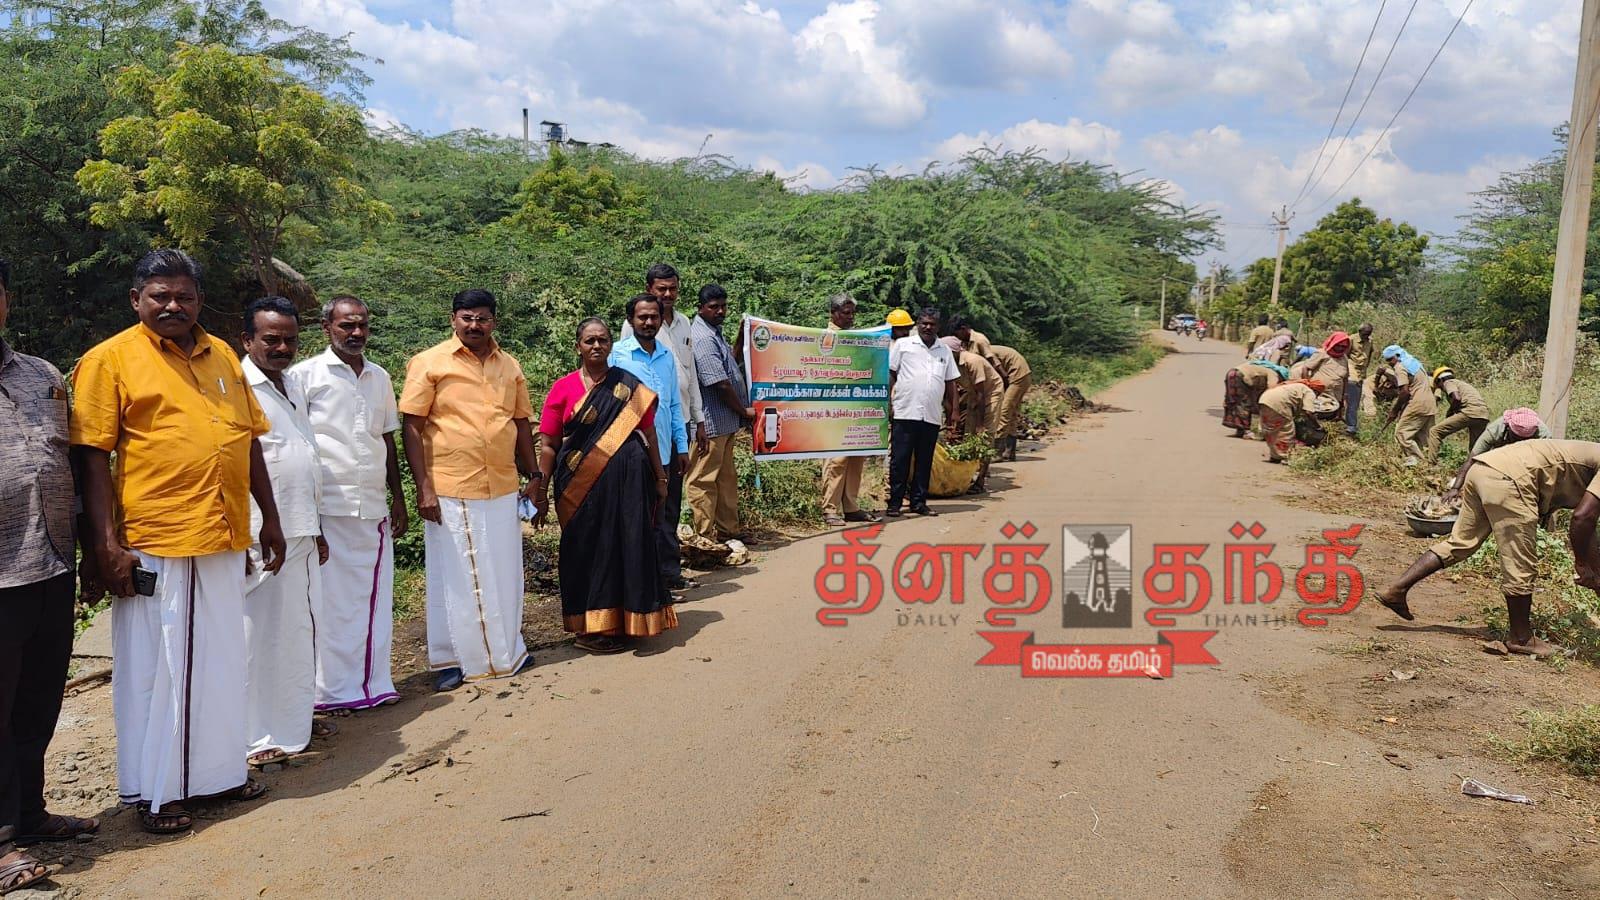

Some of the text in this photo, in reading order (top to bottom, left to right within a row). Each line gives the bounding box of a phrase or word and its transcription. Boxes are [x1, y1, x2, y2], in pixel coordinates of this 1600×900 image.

[756, 383, 888, 400] தூய்மைக்கான மக்கள் இயக்கம்
